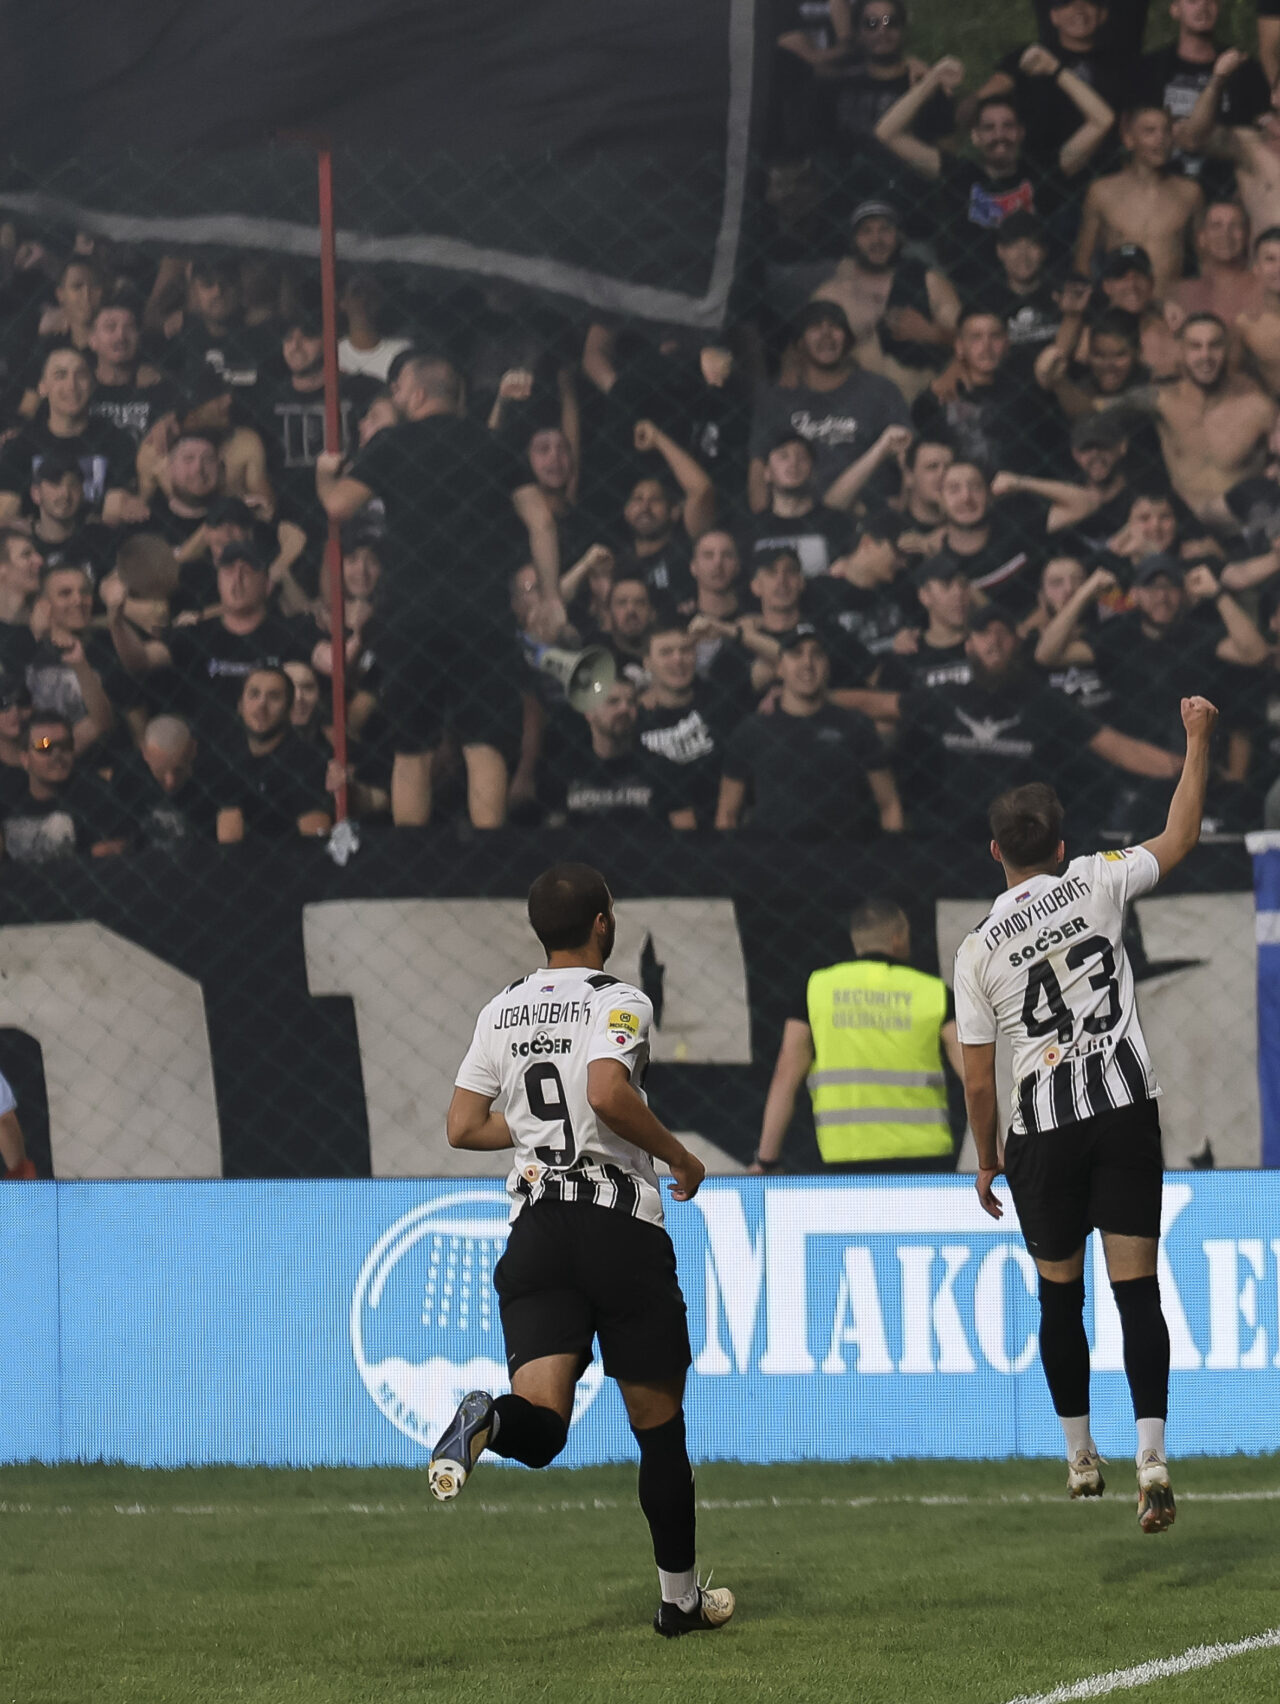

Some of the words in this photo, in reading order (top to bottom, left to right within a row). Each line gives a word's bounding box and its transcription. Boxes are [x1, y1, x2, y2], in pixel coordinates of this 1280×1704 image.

[1008, 915, 1090, 968] SOCCER
[833, 988, 912, 1006] SECURITY
[1020, 934, 1123, 1045] 43
[511, 1036, 573, 1058] SOCCER
[523, 1061, 576, 1166] 9
